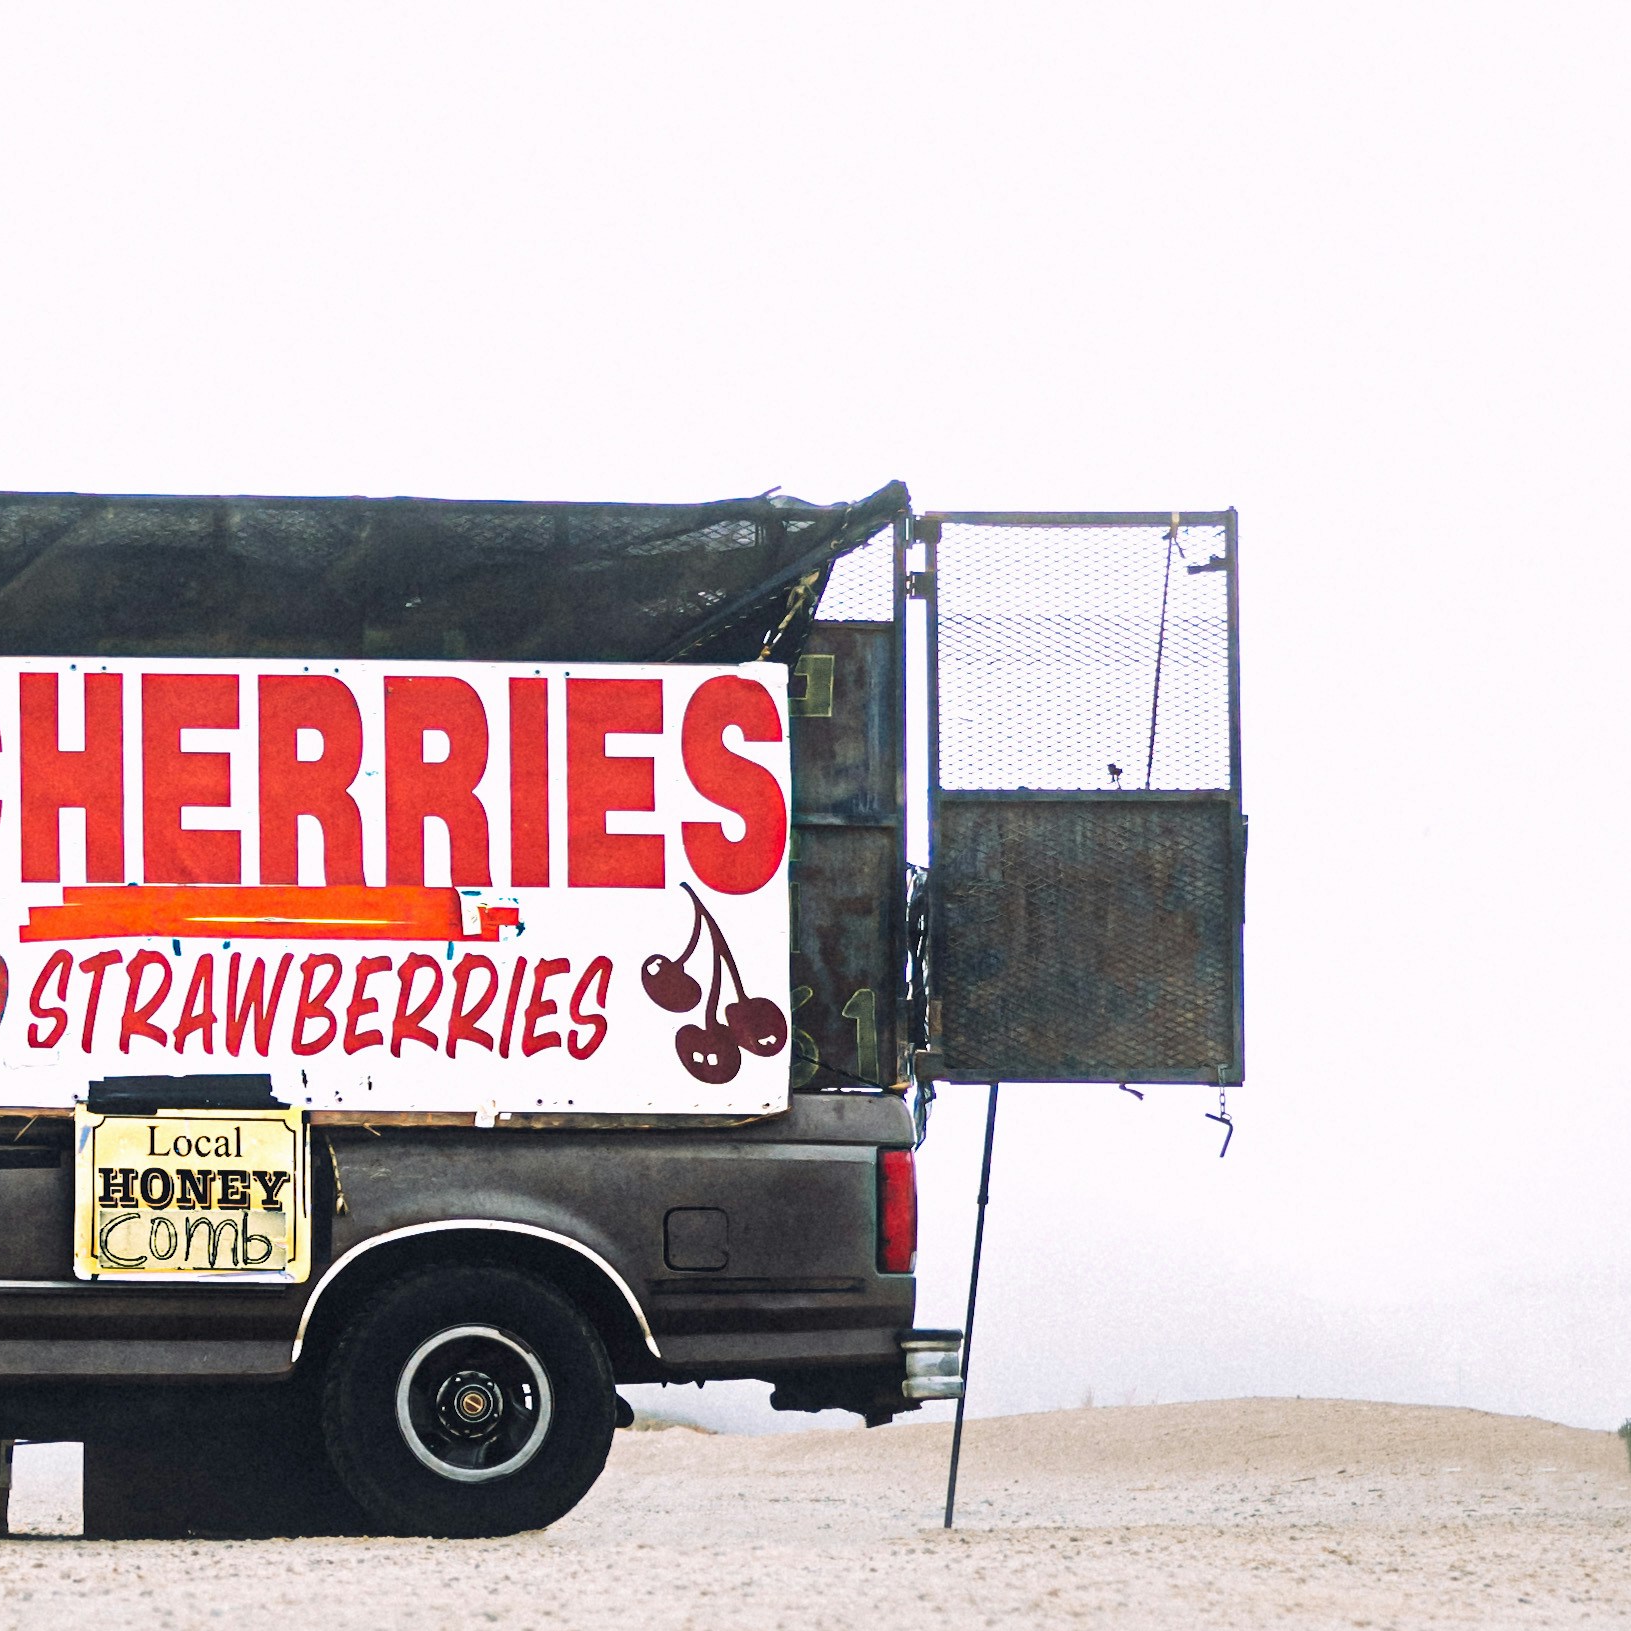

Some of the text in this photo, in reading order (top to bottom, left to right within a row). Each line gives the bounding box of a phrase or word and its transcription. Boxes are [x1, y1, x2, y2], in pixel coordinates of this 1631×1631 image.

[28, 948, 612, 1060] STRAWBERRIES
[148, 1126, 243, 1157] Local
[99, 1168, 291, 1210] HONEY
[100, 1213, 273, 1267] Comb
